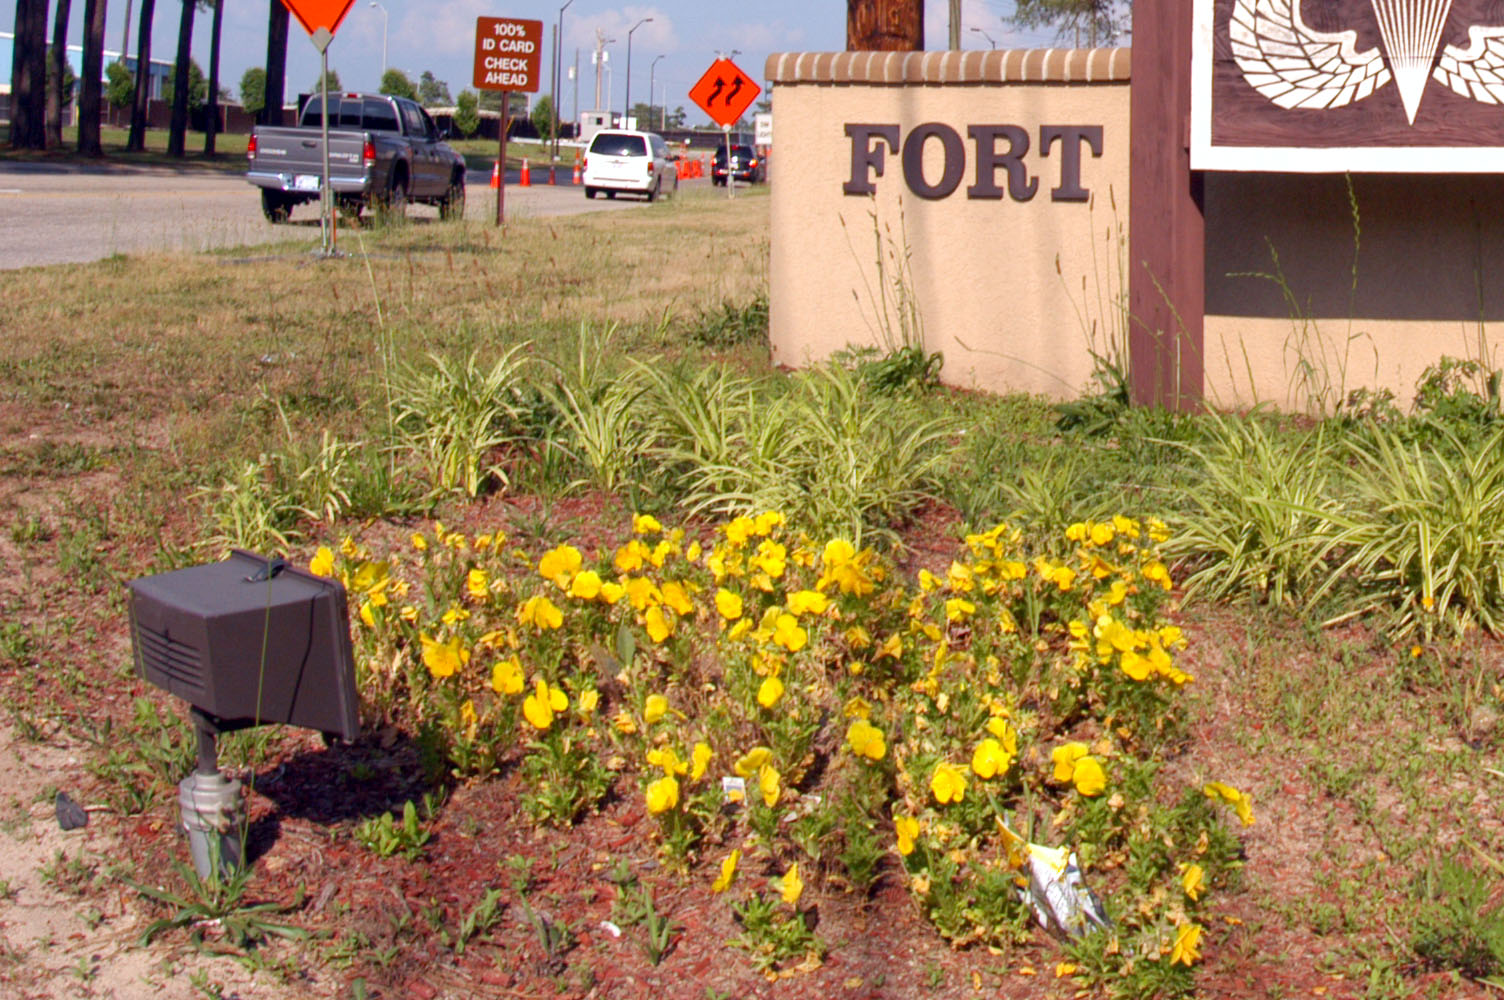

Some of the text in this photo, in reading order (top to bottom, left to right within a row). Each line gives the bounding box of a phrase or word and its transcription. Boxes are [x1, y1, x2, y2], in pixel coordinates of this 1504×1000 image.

[494, 23, 527, 37] 100%
[482, 38, 535, 54] ID CARD
[484, 56, 529, 72] CHECK
[485, 71, 528, 87] AHEAD
[842, 122, 1104, 203] FORT
